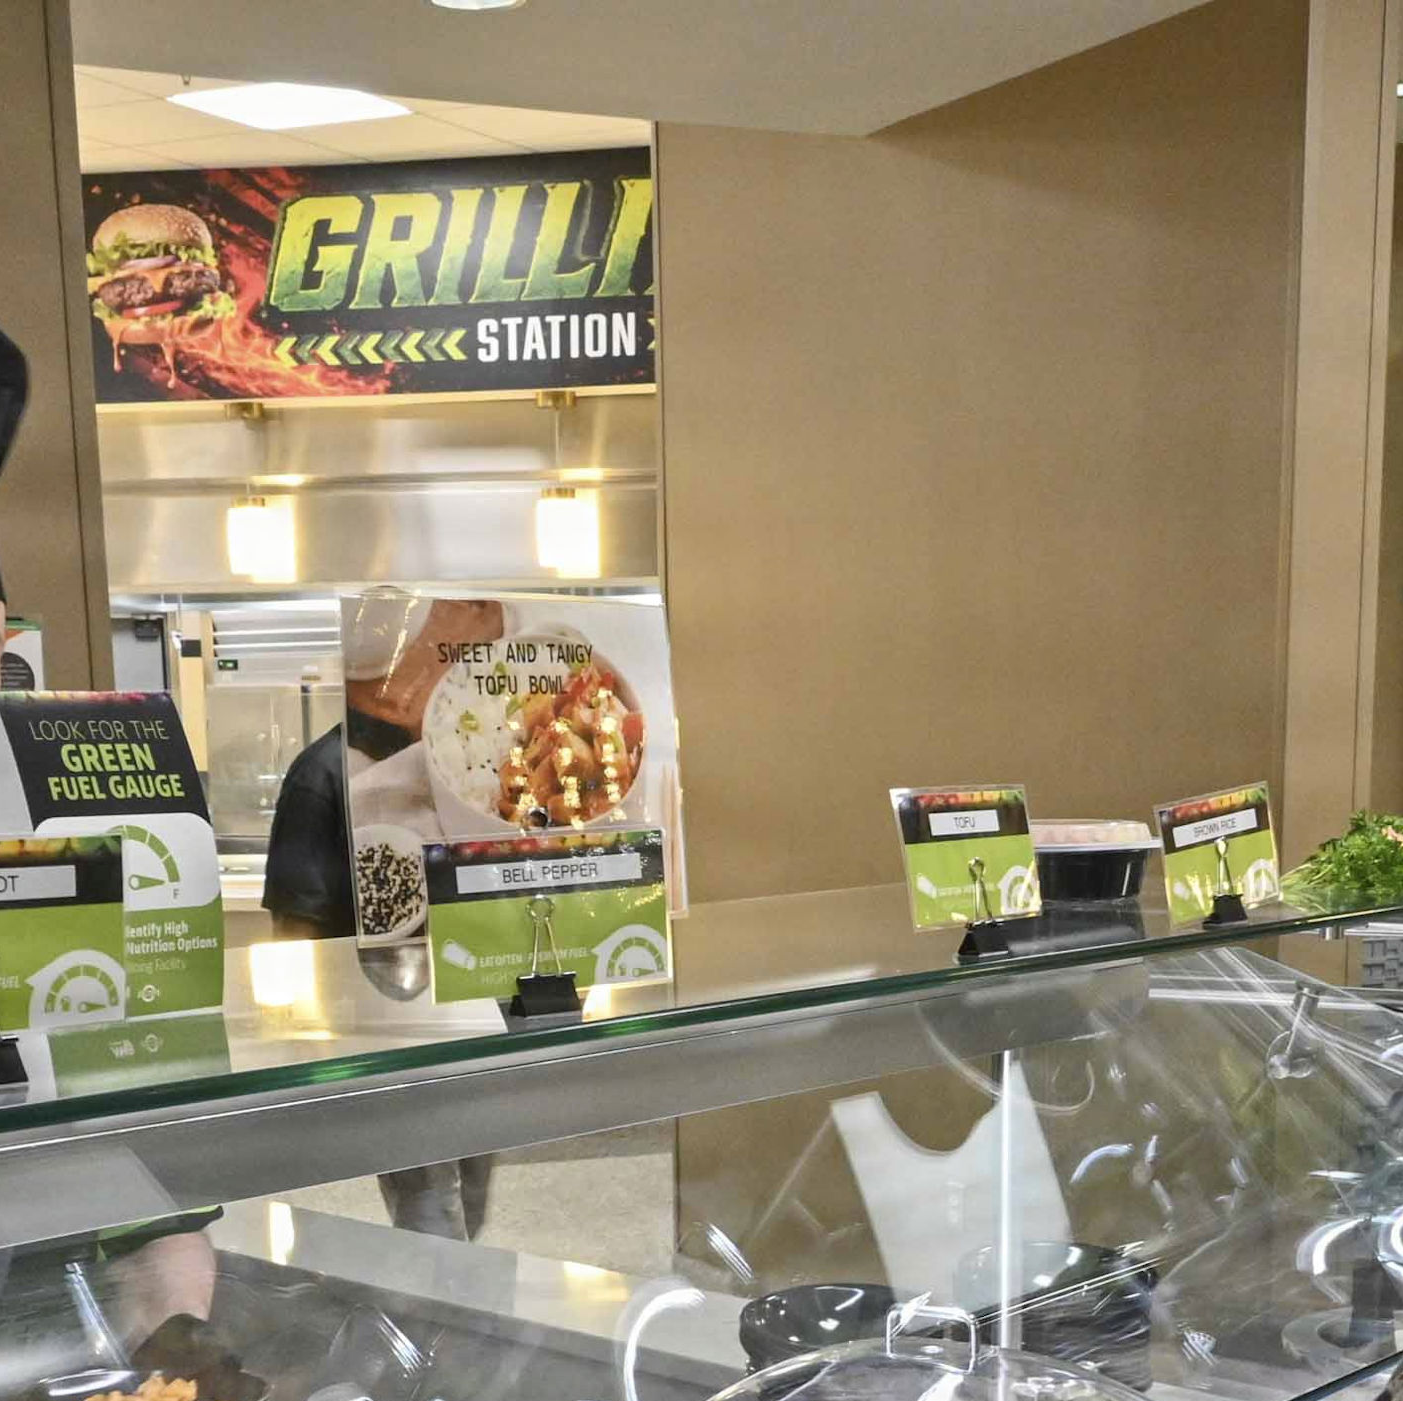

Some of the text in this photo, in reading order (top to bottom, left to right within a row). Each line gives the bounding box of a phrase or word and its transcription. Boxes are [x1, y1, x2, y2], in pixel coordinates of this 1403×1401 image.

[477, 311, 637, 362] STATION
[437, 642, 594, 664] SWEET AND TANGY
[474, 675, 568, 696] TOFU BOWL
[28, 719, 170, 741] LOOK FOR THE
[60, 742, 157, 773] GREEN
[47, 773, 186, 801] FUEL GAUGE
[502, 862, 598, 884] BELL PEPPER
[163, 920, 189, 938] High
[177, 936, 218, 953] Options
